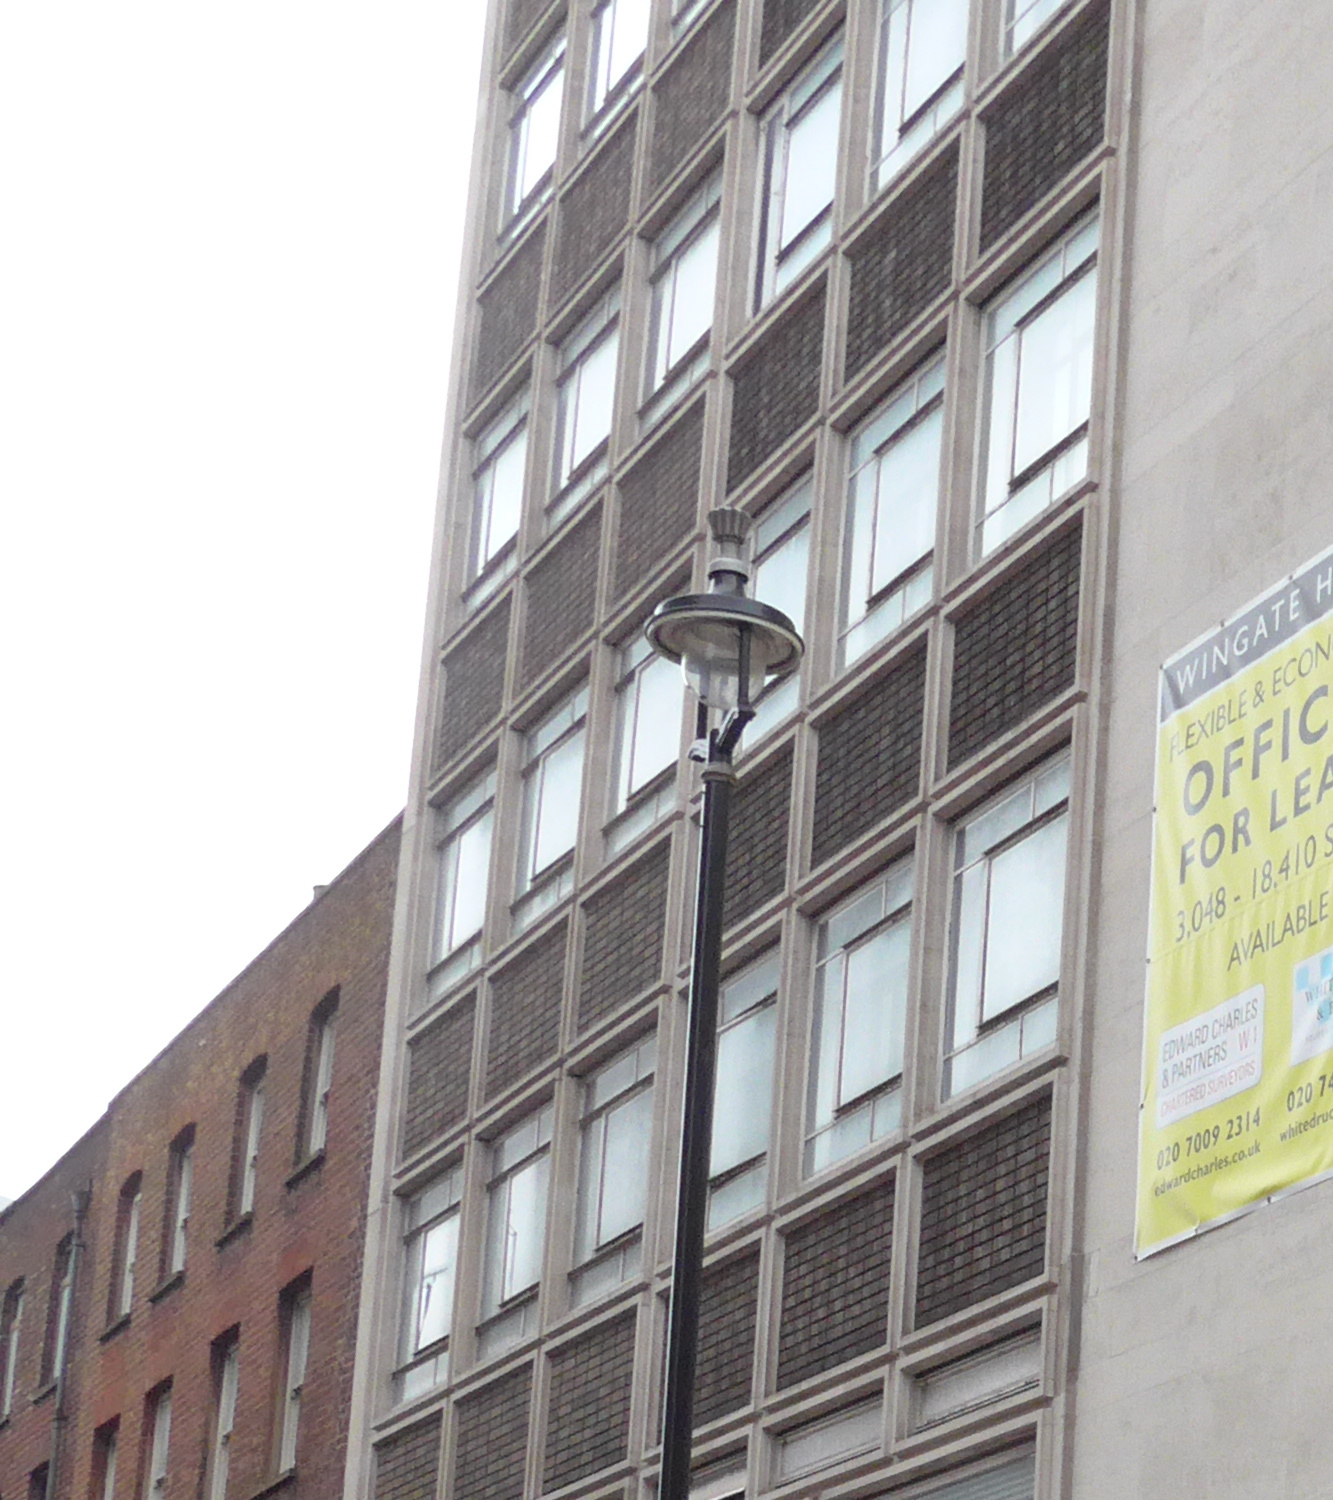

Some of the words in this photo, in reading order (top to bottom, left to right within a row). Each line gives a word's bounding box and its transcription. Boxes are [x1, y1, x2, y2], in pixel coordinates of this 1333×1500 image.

[1176, 588, 1300, 695] WINGATE
[1169, 690, 1247, 763] FLEXIBLE
[1253, 681, 1265, 709] &
[1179, 806, 1251, 885] FOR
[1227, 890, 1329, 971] AVAILABLE
[1162, 1024, 1208, 1064] EDWARD
[1211, 998, 1258, 1039] CHARLES
[1171, 1040, 1227, 1084] PARTNERS
[1286, 1083, 1312, 1113] 020
[1154, 1139, 1261, 1196] edwardcharles.co.uk
[1156, 1142, 1180, 1171] 020
[1185, 1125, 1221, 1164] 7009
[1226, 1106, 1261, 1141] 2314
